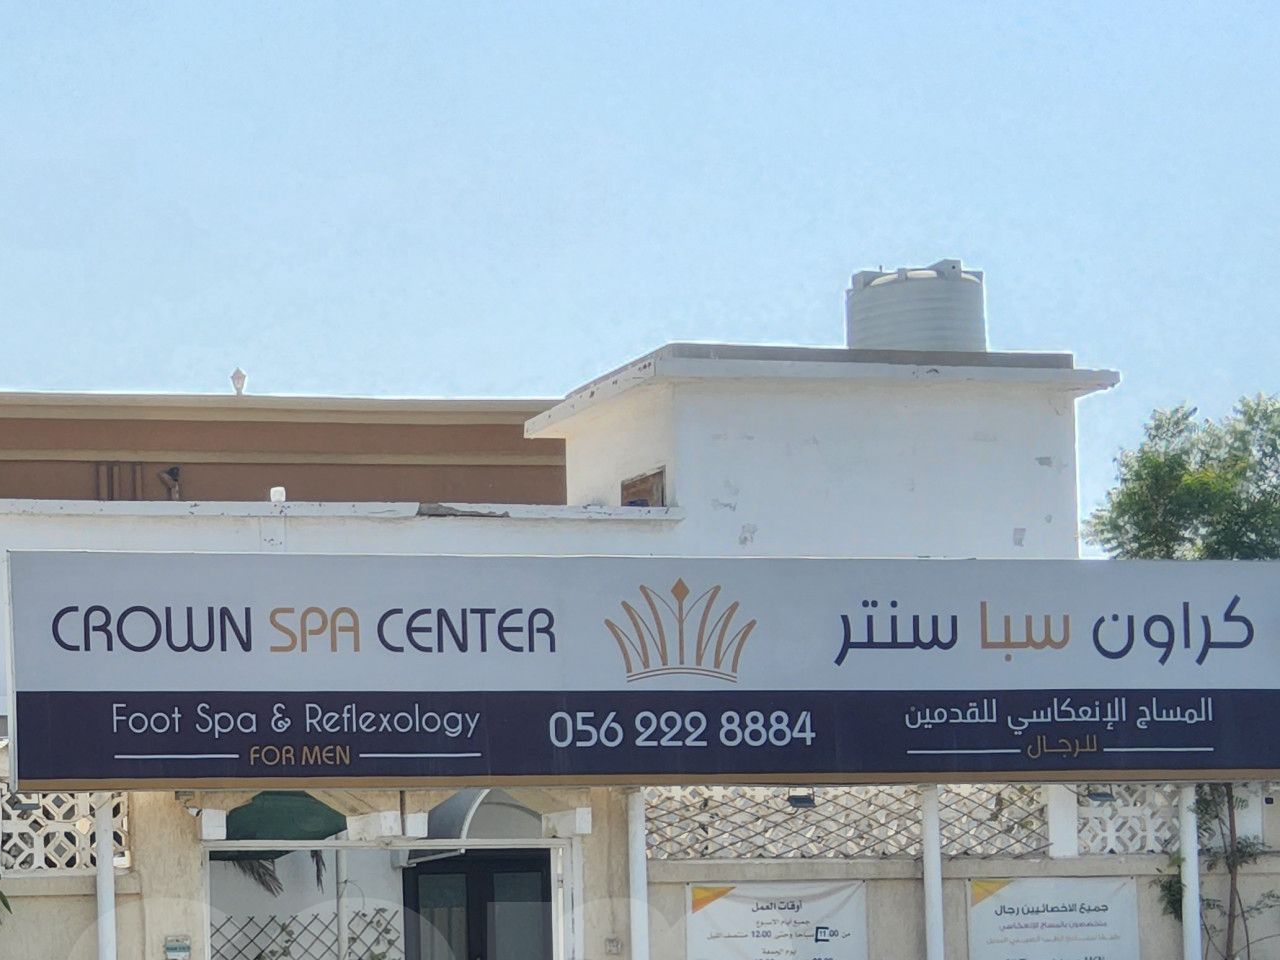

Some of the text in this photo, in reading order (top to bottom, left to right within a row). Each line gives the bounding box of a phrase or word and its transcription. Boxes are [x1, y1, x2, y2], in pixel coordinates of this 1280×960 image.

[52, 605, 556, 653] CROWN SPA CENTER
[833, 594, 1255, 667] كراون سبا سنتر
[112, 703, 481, 740] Foot Spa & Reflexology
[549, 710, 816, 748] 056 222 8884
[905, 697, 1213, 737] المساج الإنعكاسي للقدمين
[249, 745, 351, 766] FOR MEN
[1027, 734, 1098, 760] للرجال
[752, 900, 803, 913] أوقات العمل
[1079, 903, 1109, 914] جميع
